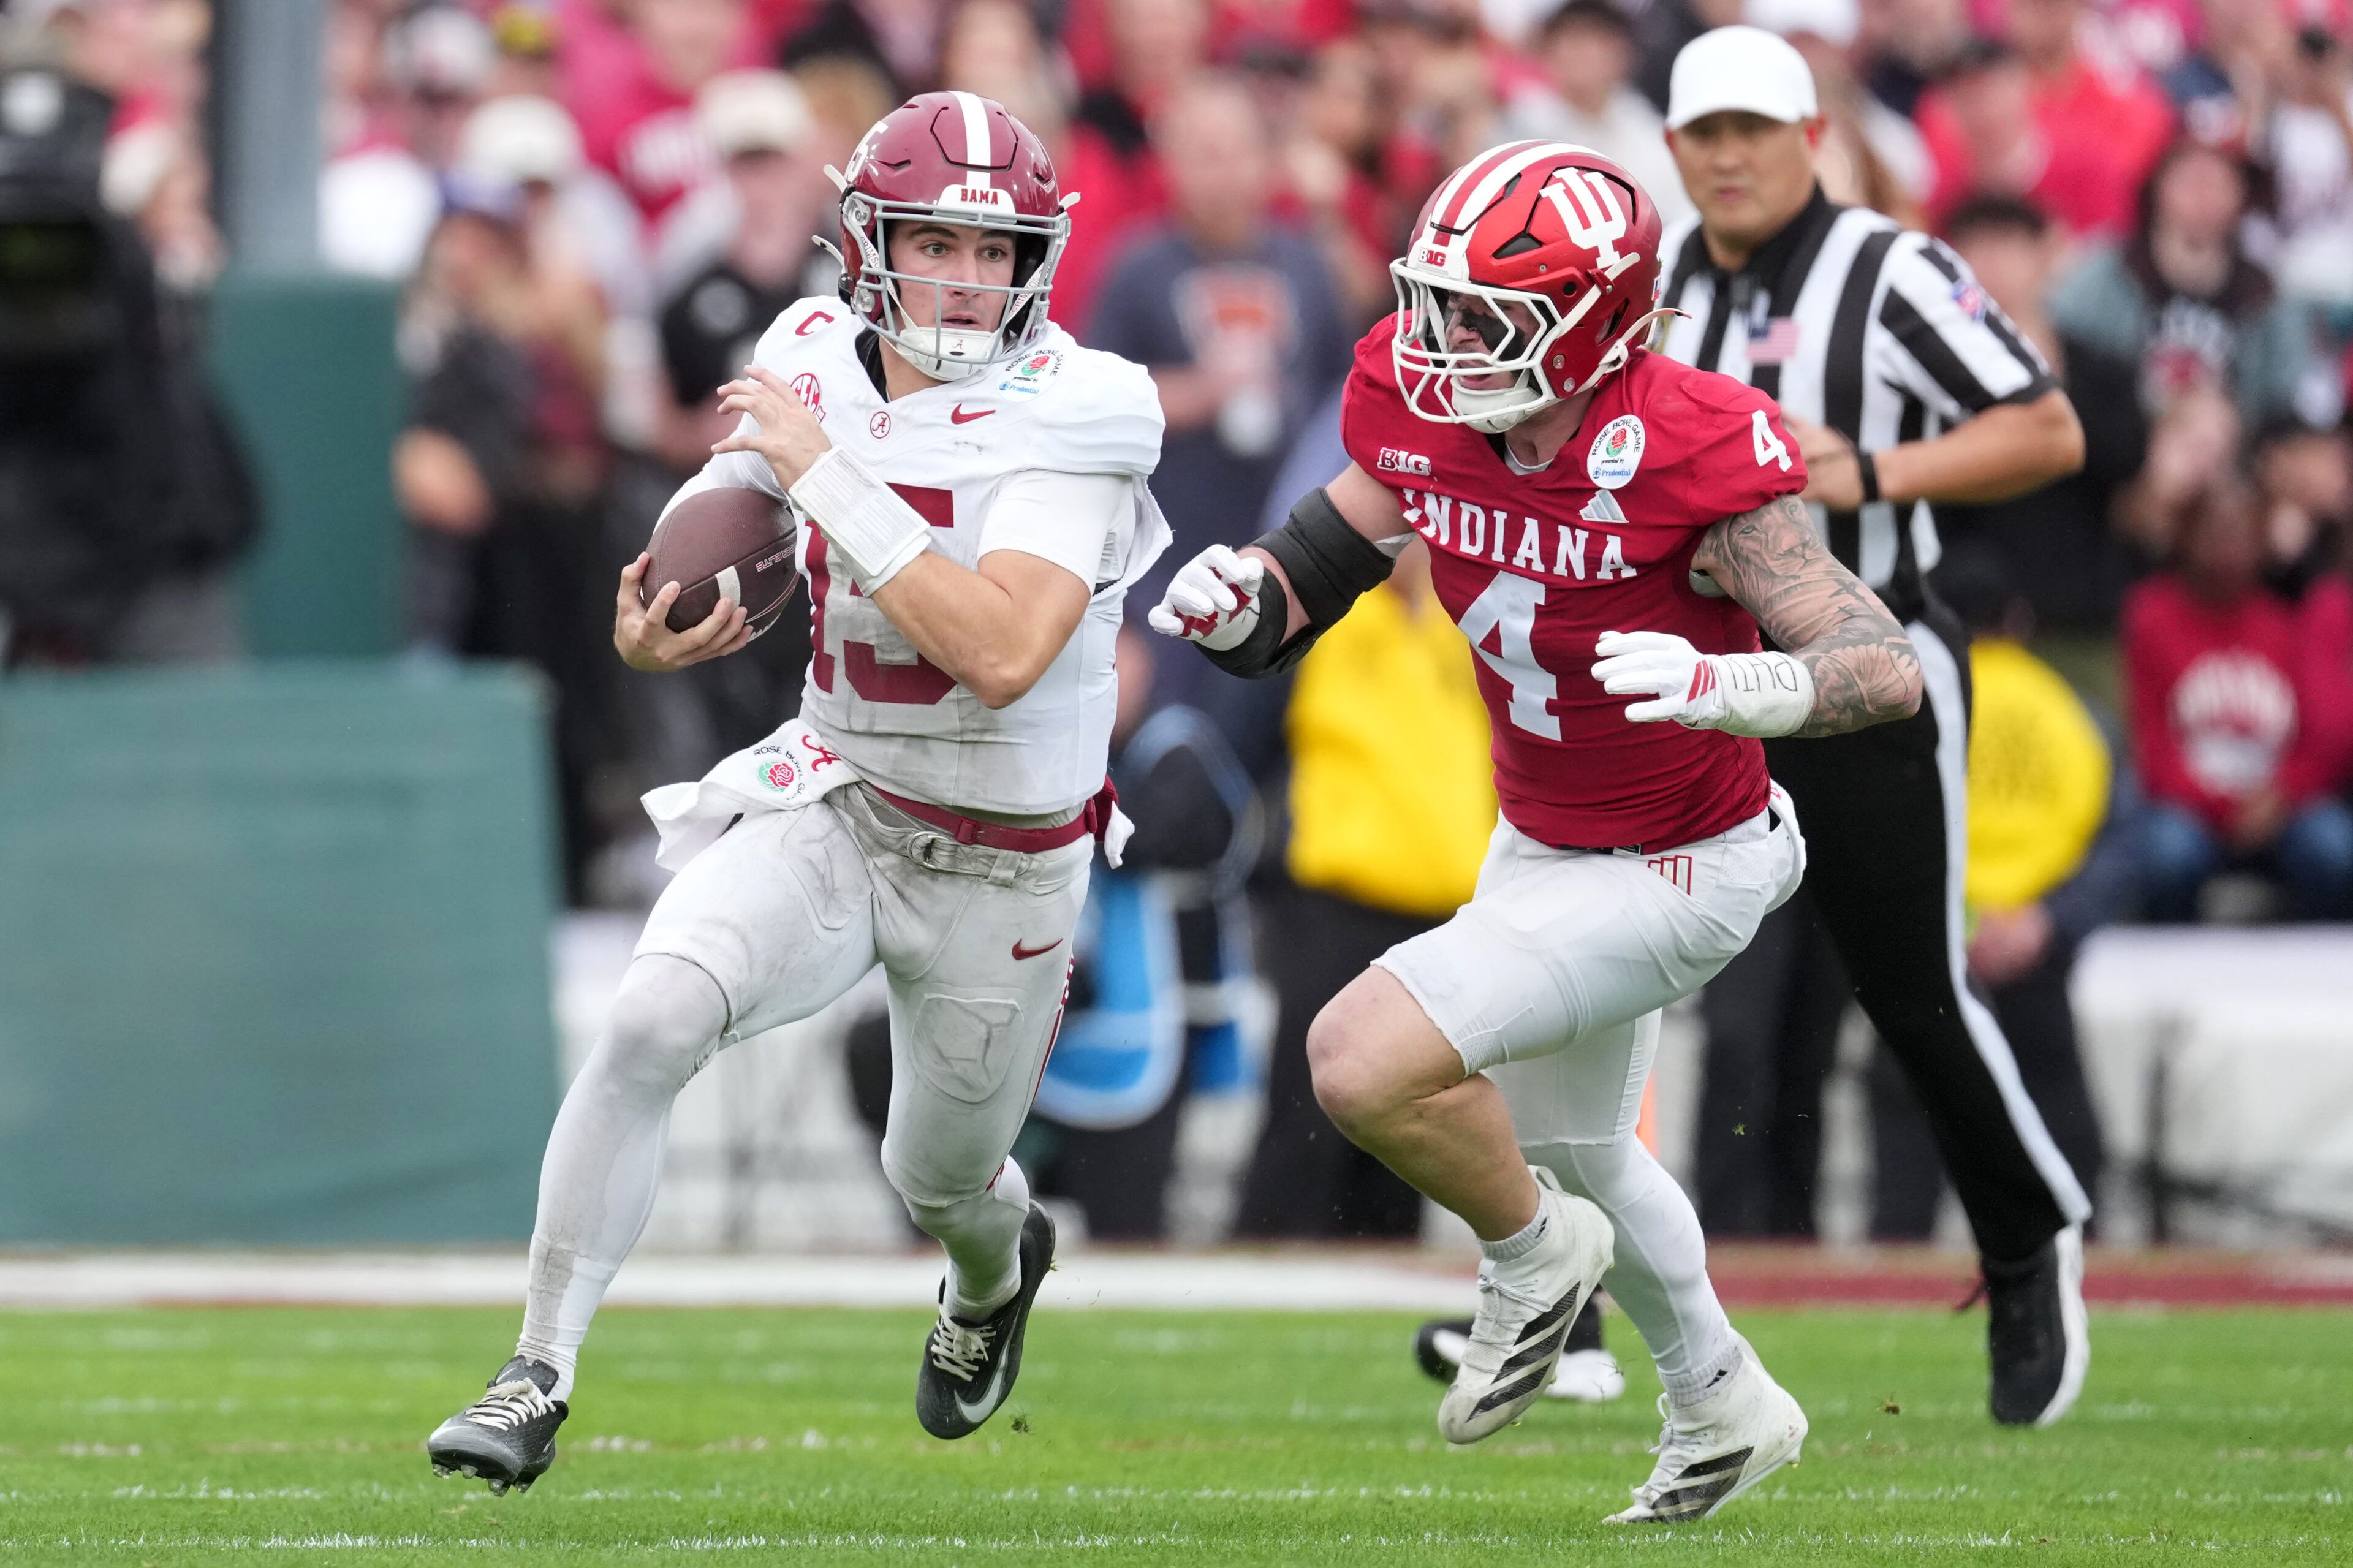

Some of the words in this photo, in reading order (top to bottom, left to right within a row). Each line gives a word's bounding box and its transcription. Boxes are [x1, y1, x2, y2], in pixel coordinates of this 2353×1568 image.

[960, 187, 999, 205] BAMA
[795, 311, 835, 336] C
[1005, 353, 1031, 371] ROSE
[1049, 354, 1063, 376] GAME
[1009, 384, 1040, 394] Prudential
[1591, 428, 1611, 455] ROSE
[1612, 419, 1632, 430] BOWL
[1632, 424, 1642, 453] GAME
[1751, 409, 1793, 472] 4
[1602, 468, 1631, 477] Prudential
[1402, 488, 1637, 580] INDIANA
[755, 552, 782, 572] ELITE
[1458, 570, 1562, 742] 4
[753, 745, 782, 757] ROSE
[785, 750, 804, 782] BOWL
